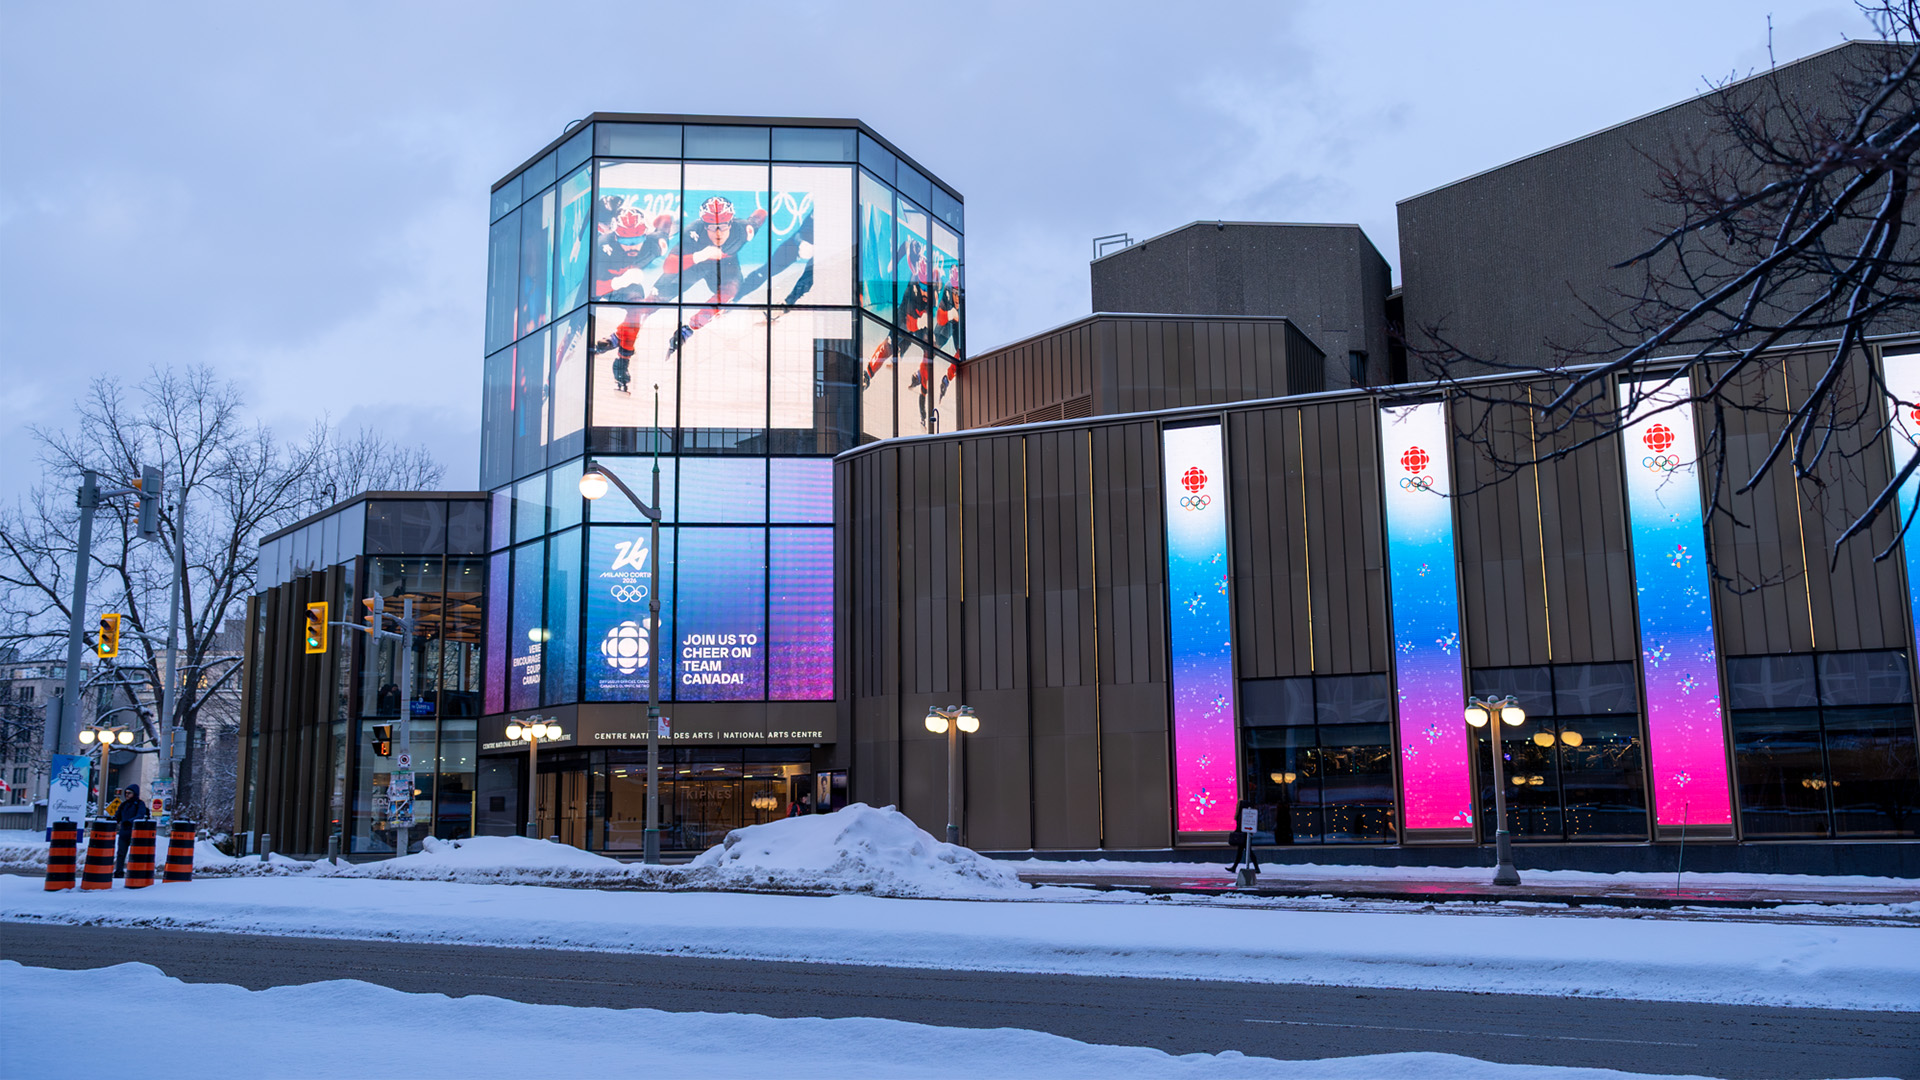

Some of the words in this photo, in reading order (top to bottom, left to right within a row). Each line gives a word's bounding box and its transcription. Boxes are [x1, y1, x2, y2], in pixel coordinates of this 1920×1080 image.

[682, 634, 716, 646] JOIN
[718, 634, 737, 646] US
[738, 634, 757, 646] TO
[528, 643, 542, 654] VENE
[682, 647, 729, 659] CHEER
[731, 647, 752, 659] ON
[513, 653, 541, 667] ENCOURAGE
[682, 660, 722, 672] TEAM
[682, 673, 744, 685] CANADA!
[594, 732, 628, 740] CENTRE
[723, 731, 765, 739] NATIONAL
[686, 789, 733, 800] KIPNES
